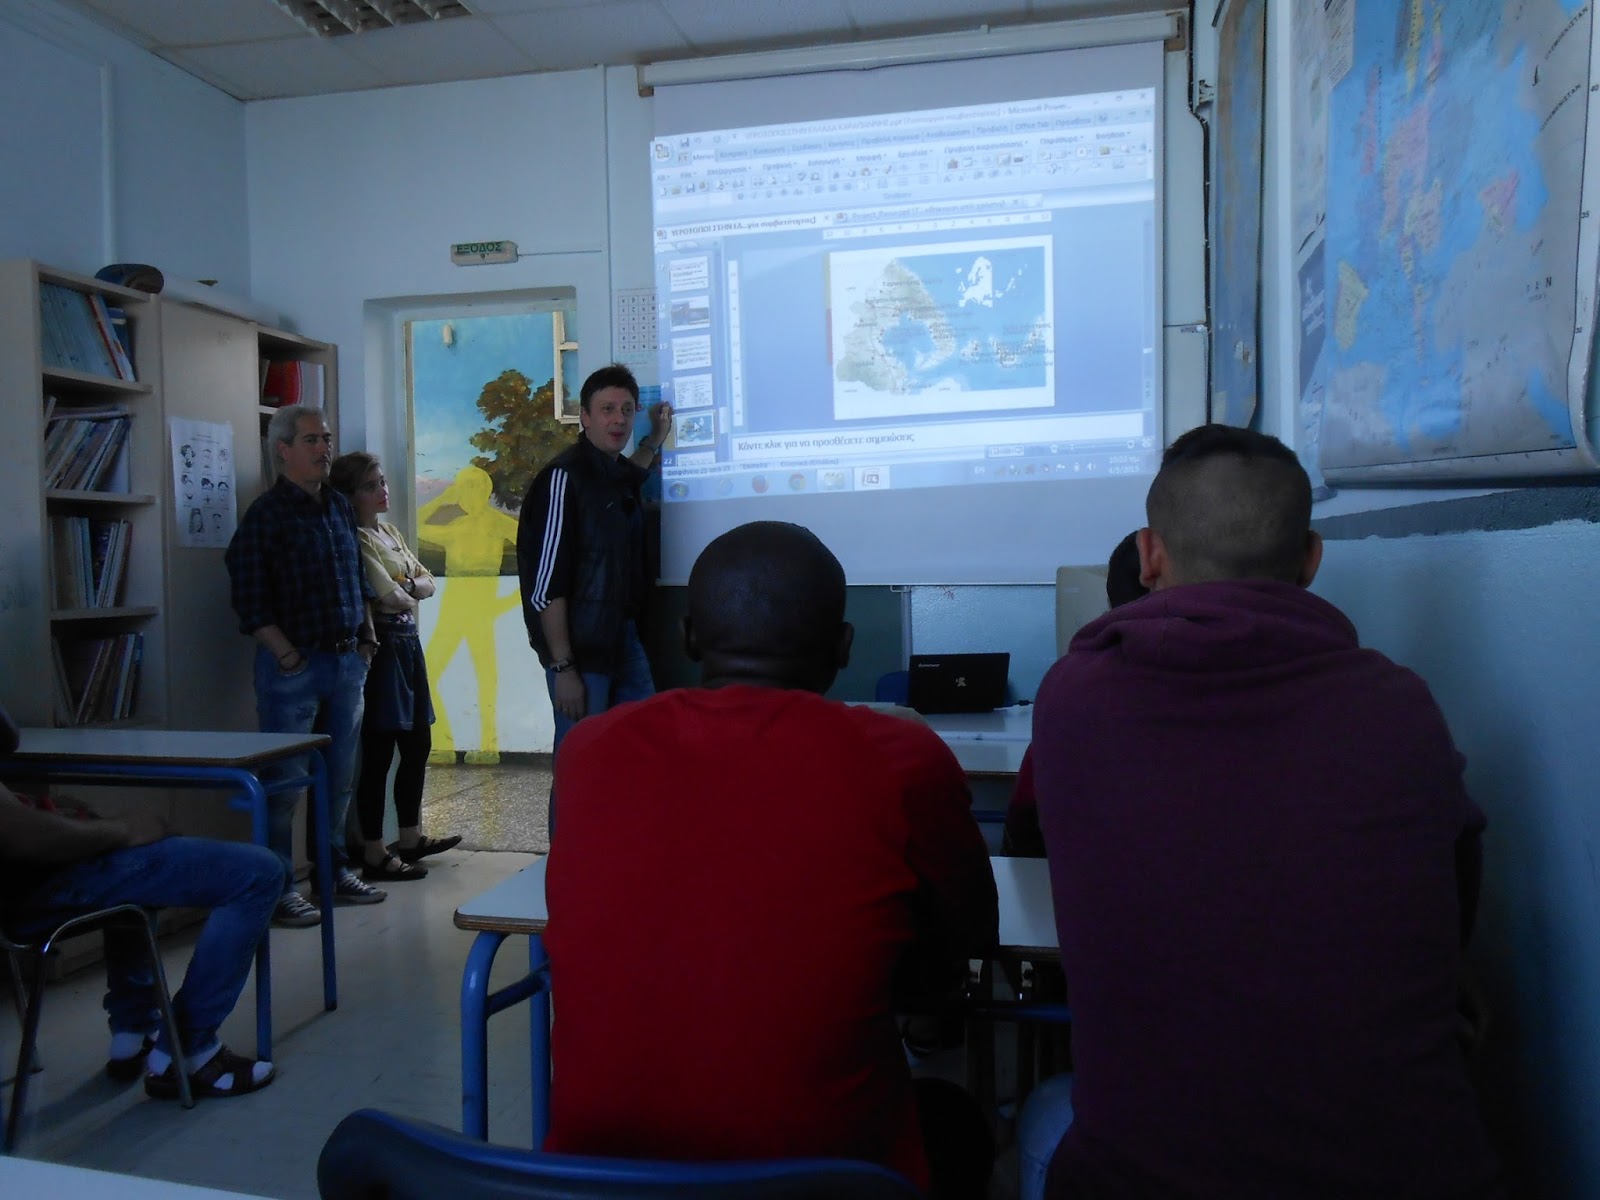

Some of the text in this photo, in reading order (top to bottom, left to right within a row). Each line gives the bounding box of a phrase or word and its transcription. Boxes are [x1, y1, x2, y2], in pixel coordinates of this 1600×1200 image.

[456, 241, 503, 254] ΕΞΟΔΟΣ
[738, 442, 763, 451] Κάντε
[765, 440, 781, 449] κλικ
[784, 440, 797, 450] για
[813, 436, 864, 448] προσθέσετε
[866, 432, 915, 445] σημειώσεις
